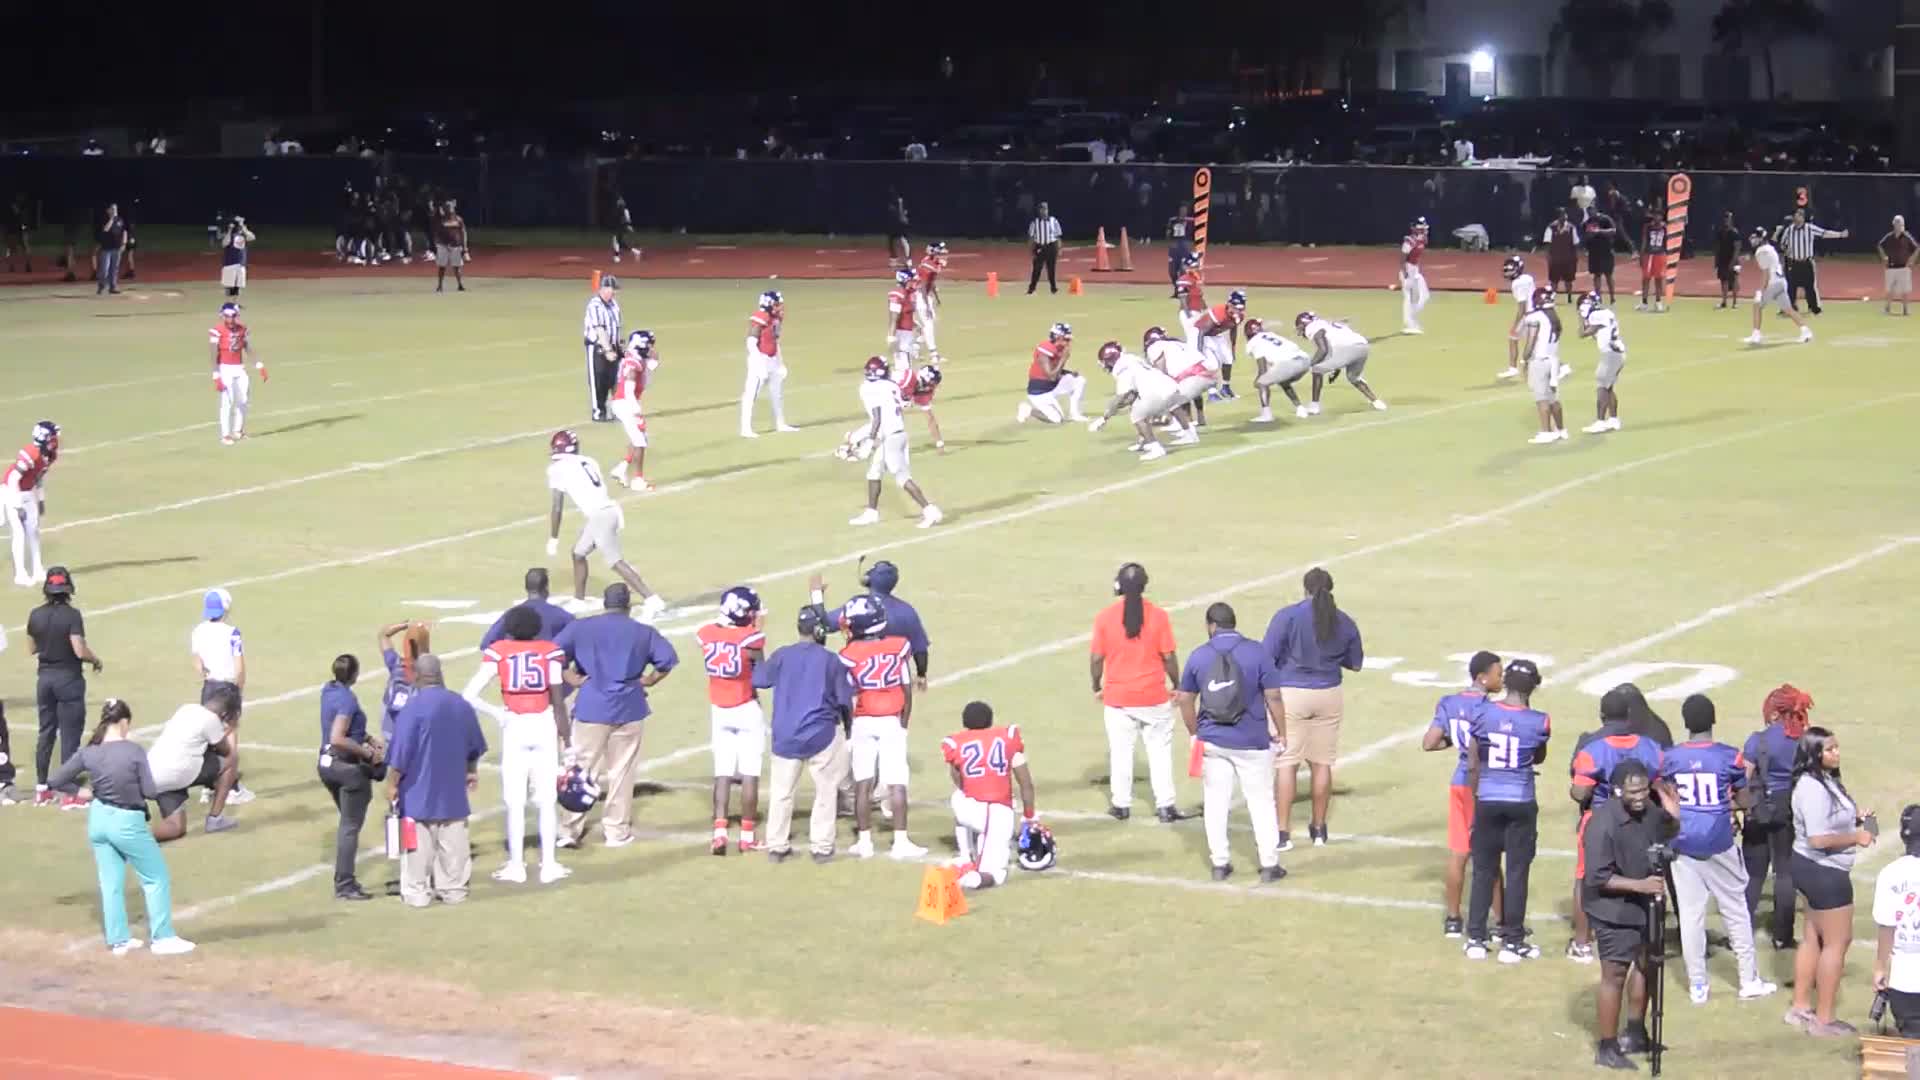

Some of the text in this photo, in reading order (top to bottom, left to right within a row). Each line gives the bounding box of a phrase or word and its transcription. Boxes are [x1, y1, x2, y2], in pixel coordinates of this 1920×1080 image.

[506, 650, 546, 692] 15
[704, 641, 742, 679] 23
[856, 652, 900, 690] 22
[960, 737, 1008, 777] 24
[1487, 732, 1520, 769] 21
[1674, 772, 1720, 806] 30
